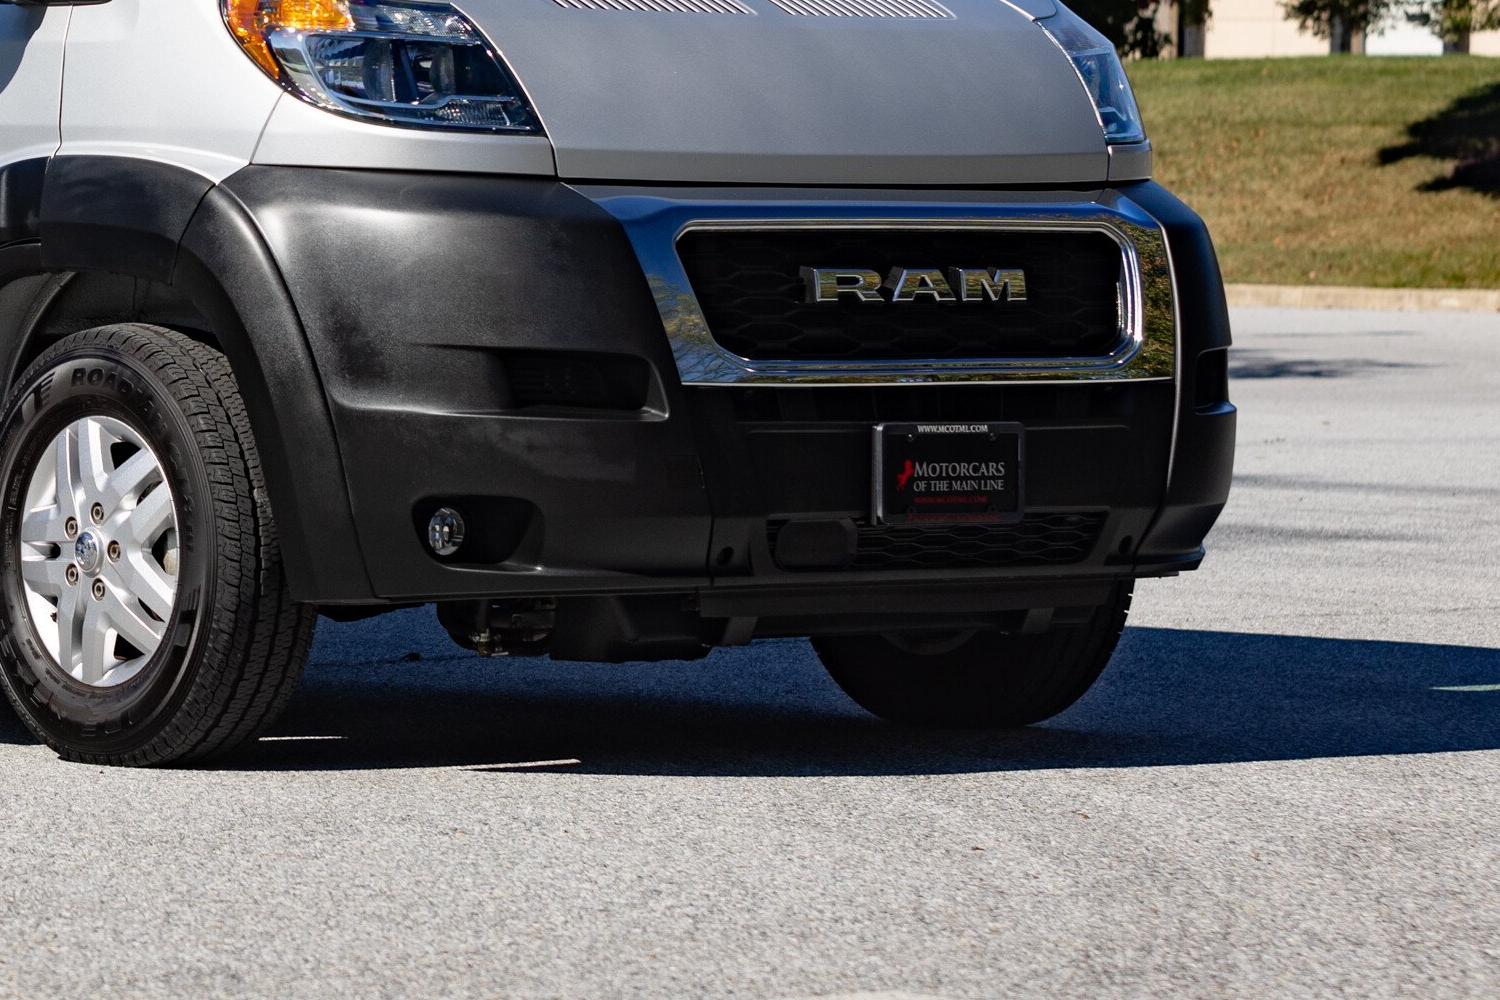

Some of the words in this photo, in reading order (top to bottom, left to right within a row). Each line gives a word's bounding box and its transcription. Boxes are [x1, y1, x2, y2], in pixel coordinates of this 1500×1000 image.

[800, 265, 1028, 302] RAM
[914, 461, 1005, 477] MOTORCARS
[913, 480, 928, 492] OF
[930, 480, 950, 491] THE
[952, 480, 979, 491] MAIN
[981, 479, 1005, 490] LINE
